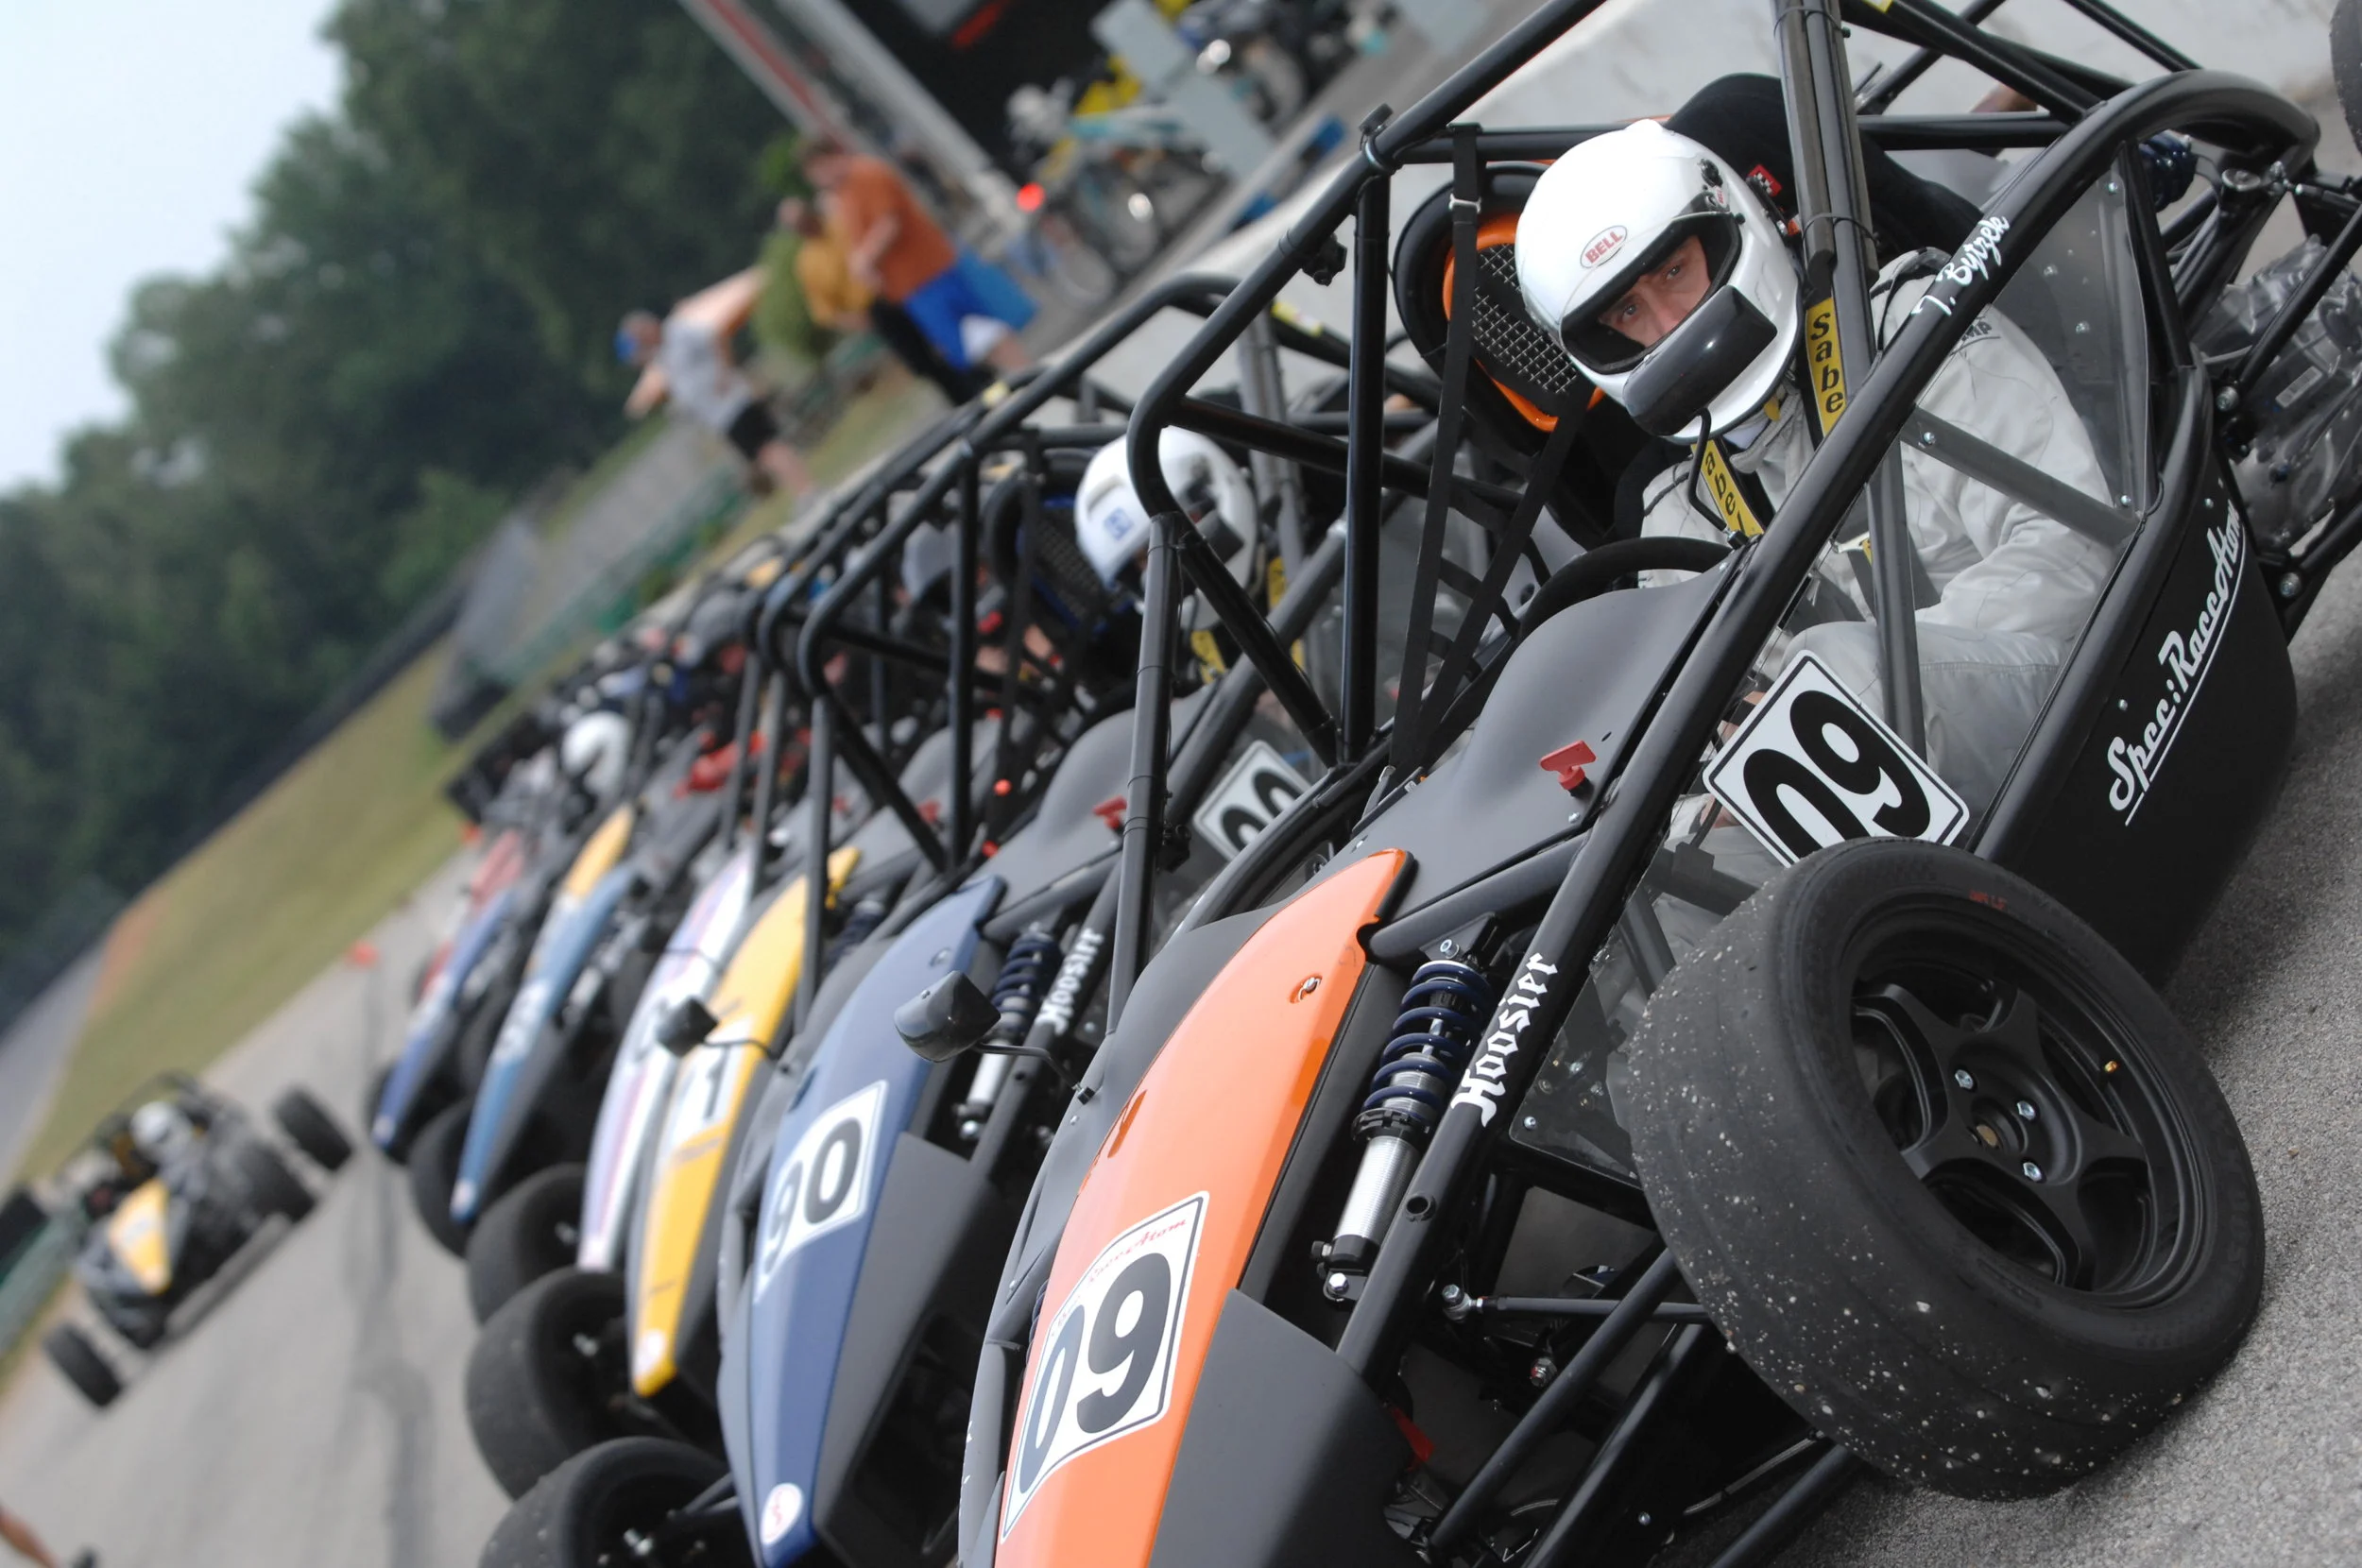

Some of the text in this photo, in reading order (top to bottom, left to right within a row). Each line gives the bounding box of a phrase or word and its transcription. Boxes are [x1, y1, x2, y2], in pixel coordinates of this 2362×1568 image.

[1584, 230, 1623, 264] BELL
[1810, 312, 1844, 414] Sabe
[1705, 452, 1746, 537] abel
[1743, 690, 1930, 859] 09
[1450, 952, 1558, 1128] Hoosier
[763, 1116, 863, 1275] 90
[1019, 1253, 1172, 1494] 09
